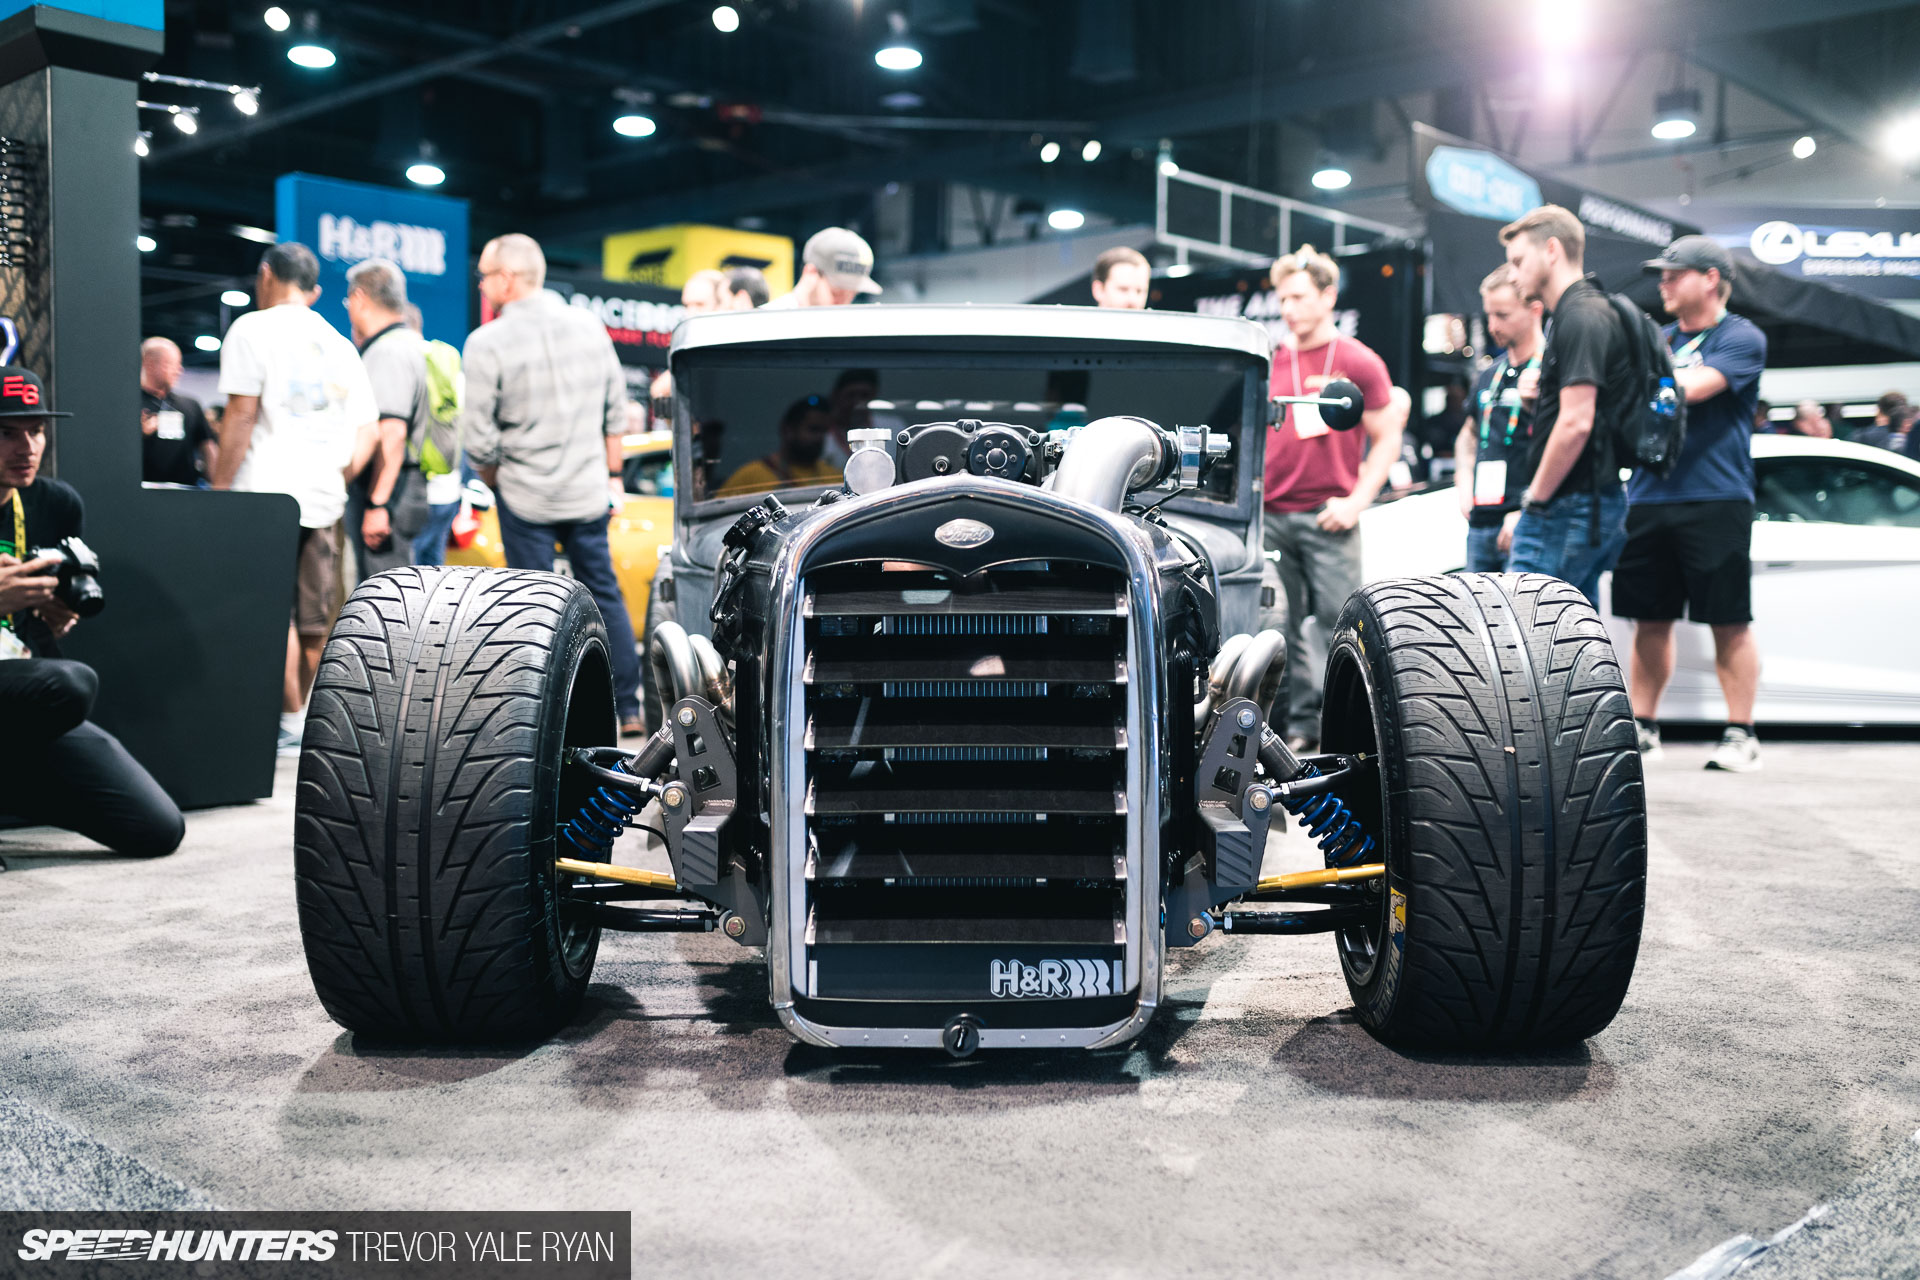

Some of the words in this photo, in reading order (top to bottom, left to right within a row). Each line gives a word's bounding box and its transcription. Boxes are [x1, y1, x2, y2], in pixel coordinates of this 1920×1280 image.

[3, 376, 40, 405] E6
[939, 523, 991, 543] Ford
[991, 959, 1070, 998] H&R
